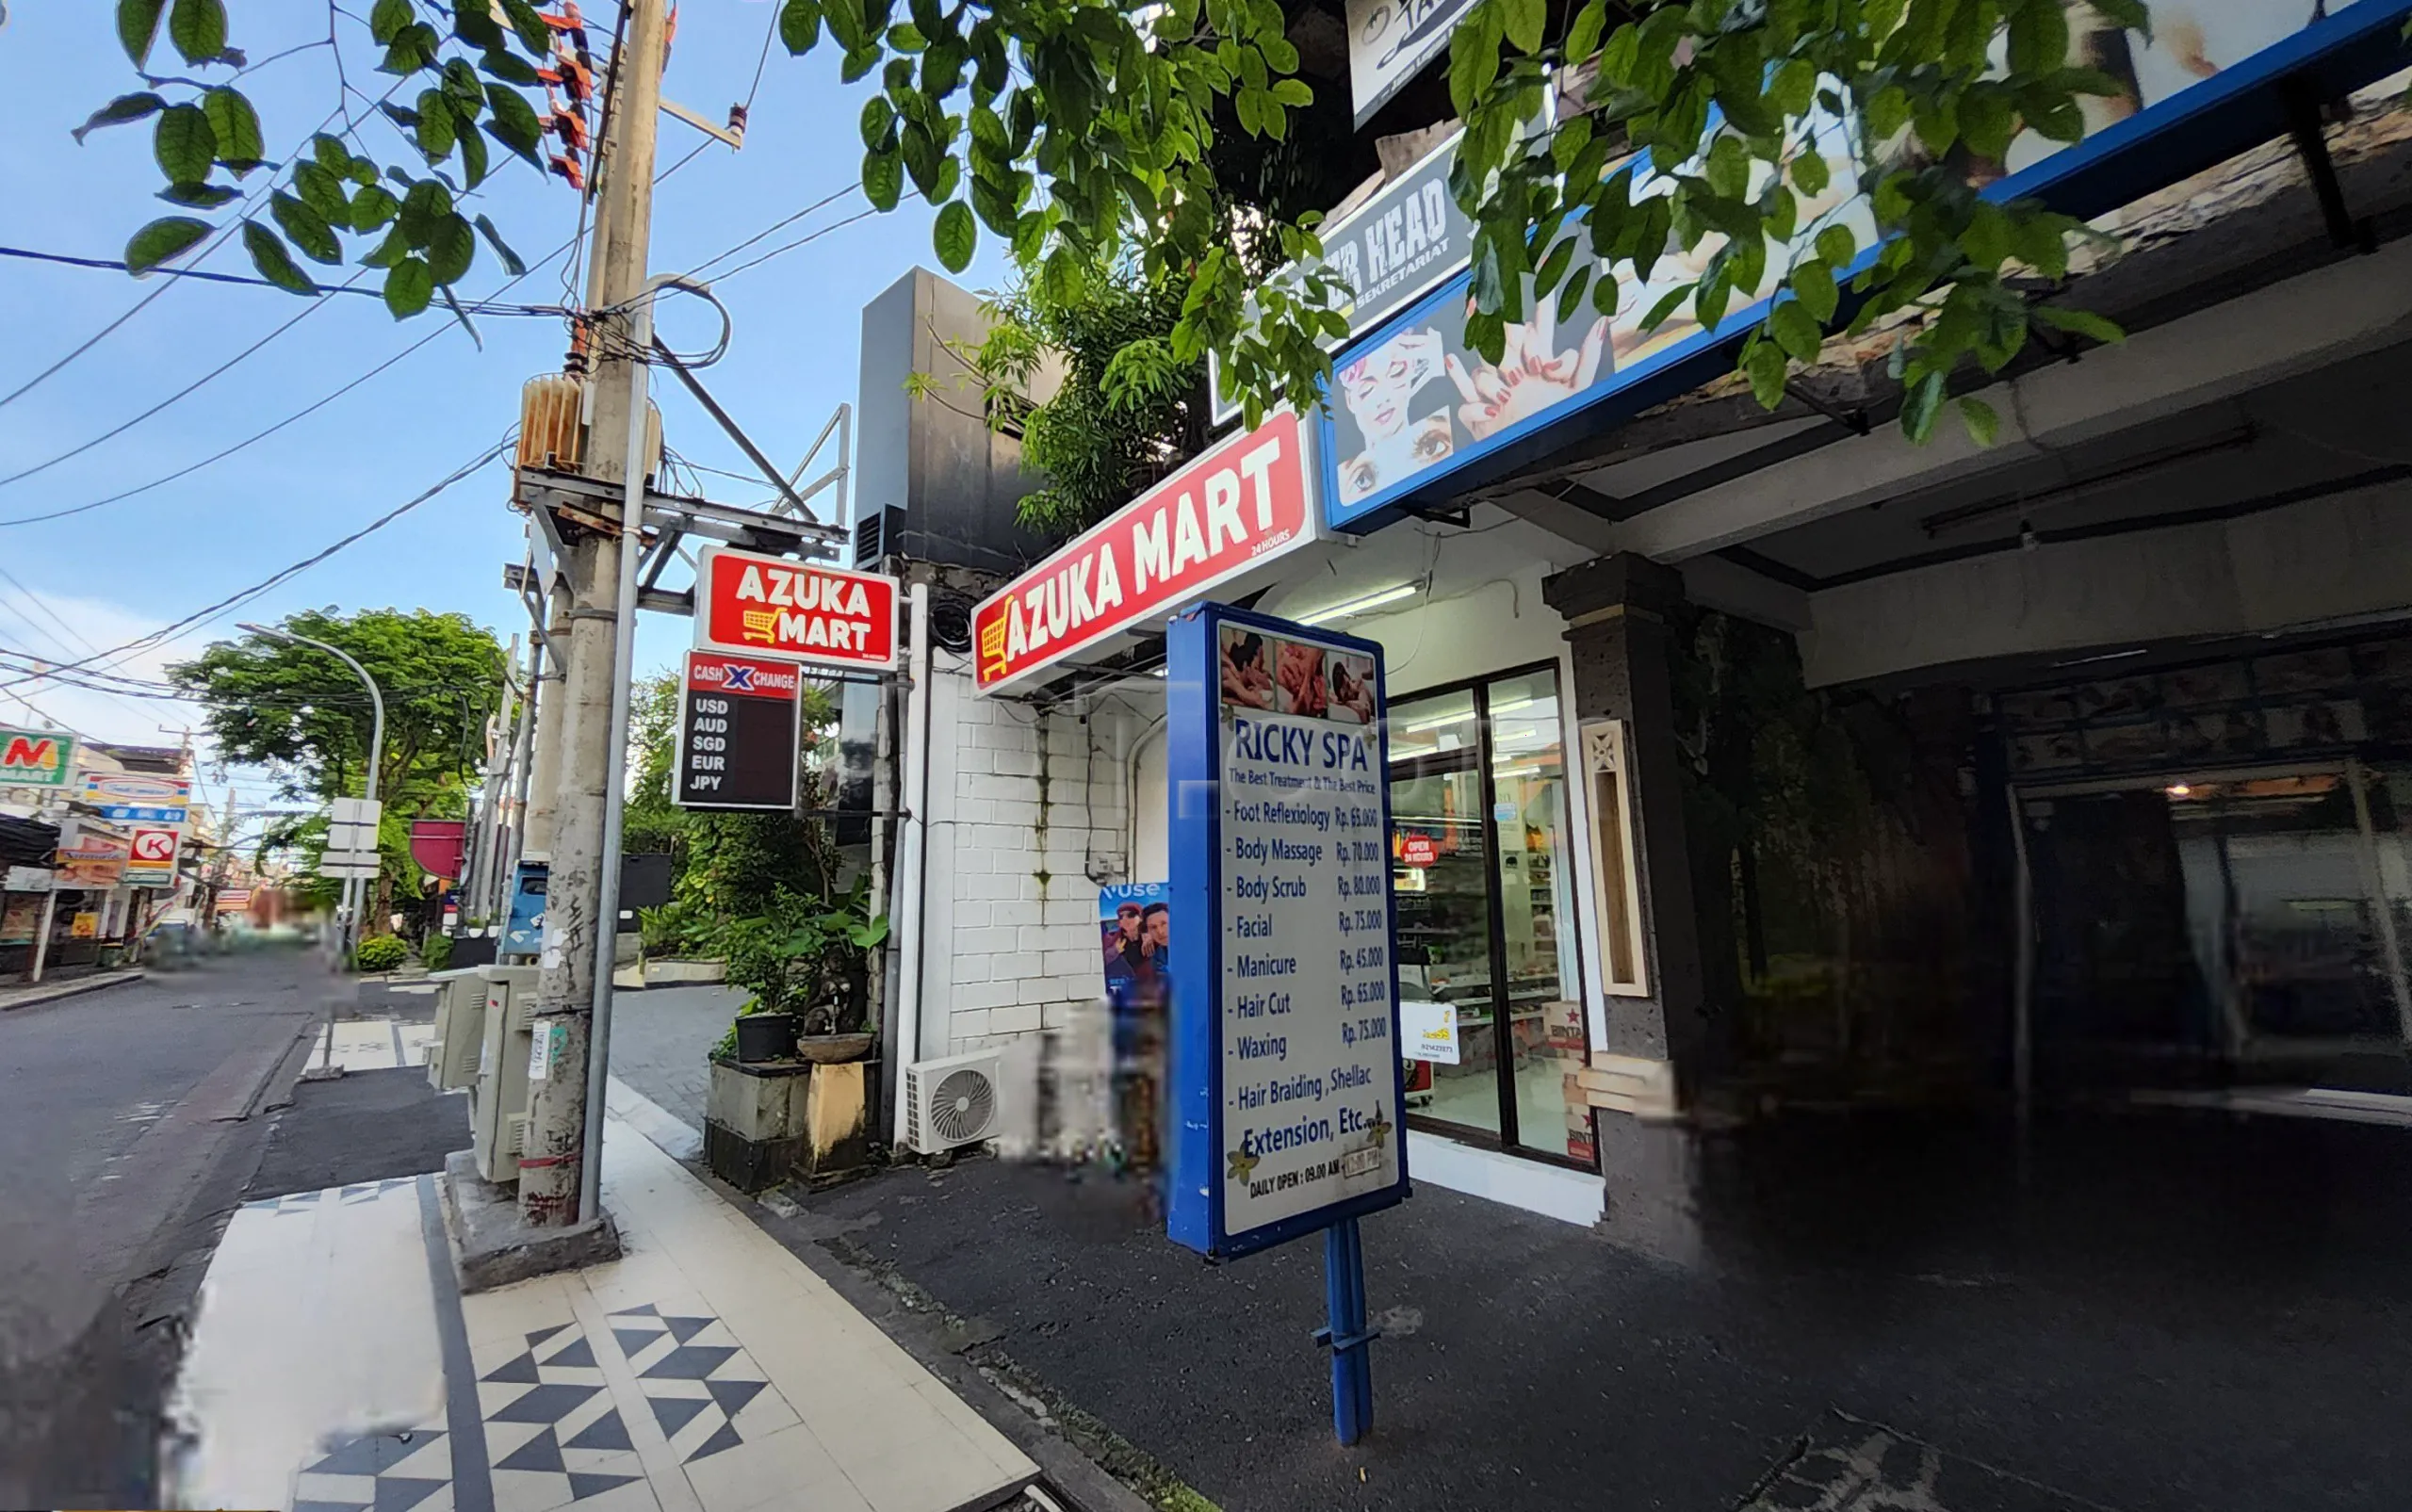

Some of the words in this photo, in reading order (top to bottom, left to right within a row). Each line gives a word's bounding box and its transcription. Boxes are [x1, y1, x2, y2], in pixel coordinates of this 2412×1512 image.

[1365, 178, 1447, 285] HEAD
[1357, 237, 1450, 309] SEKRETARIAT
[1006, 542, 1123, 663] AZUKA
[1132, 436, 1280, 595] MART
[1251, 545, 1262, 557] 24
[1262, 528, 1291, 553] HOURS
[736, 565, 871, 618] AZUKA
[778, 612, 872, 652] MART
[693, 664, 723, 683] CASH
[753, 671, 795, 690] CHANGE
[695, 697, 729, 715] USD
[693, 717, 728, 734] AUD
[692, 735, 726, 753] SGD
[1236, 719, 1314, 766] RICKY
[1323, 731, 1368, 772] SPA
[691, 754, 725, 772] EUR
[689, 774, 722, 792] JPY
[1229, 768, 1246, 783] The
[1248, 770, 1267, 785] Best
[1269, 772, 1312, 789] Treatment
[1340, 779, 1357, 792] Best
[1357, 780, 1377, 795] Price
[1234, 799, 1260, 821] Foot
[1263, 802, 1330, 832] Reflexiology
[1335, 806, 1350, 832] Rp.
[1236, 837, 1268, 865] Body
[1272, 837, 1323, 867] Massage
[1336, 841, 1351, 867] Rp.
[1236, 876, 1268, 905] Body
[1272, 875, 1307, 898] Scrub
[1338, 877, 1352, 902] Rp.
[1236, 914, 1273, 938] Facial
[1339, 911, 1354, 937] Rp.
[1355, 910, 1382, 931] 75.000
[1237, 952, 1296, 979] Manicure
[1340, 951, 1355, 976] Rp.
[1237, 994, 1265, 1019] Hair
[1268, 992, 1292, 1015] Cut
[1341, 986, 1356, 1013] Rp.
[1342, 1023, 1357, 1048] Rp.
[1358, 1016, 1387, 1040] 75.000
[1237, 1032, 1287, 1061] Waxing
[1238, 1084, 1266, 1112] Hair
[1270, 1074, 1323, 1108] Braiding
[1244, 1114, 1335, 1159] Extension,
[1250, 1176, 1276, 1199] DAILY
[1277, 1170, 1298, 1191] OPEN
